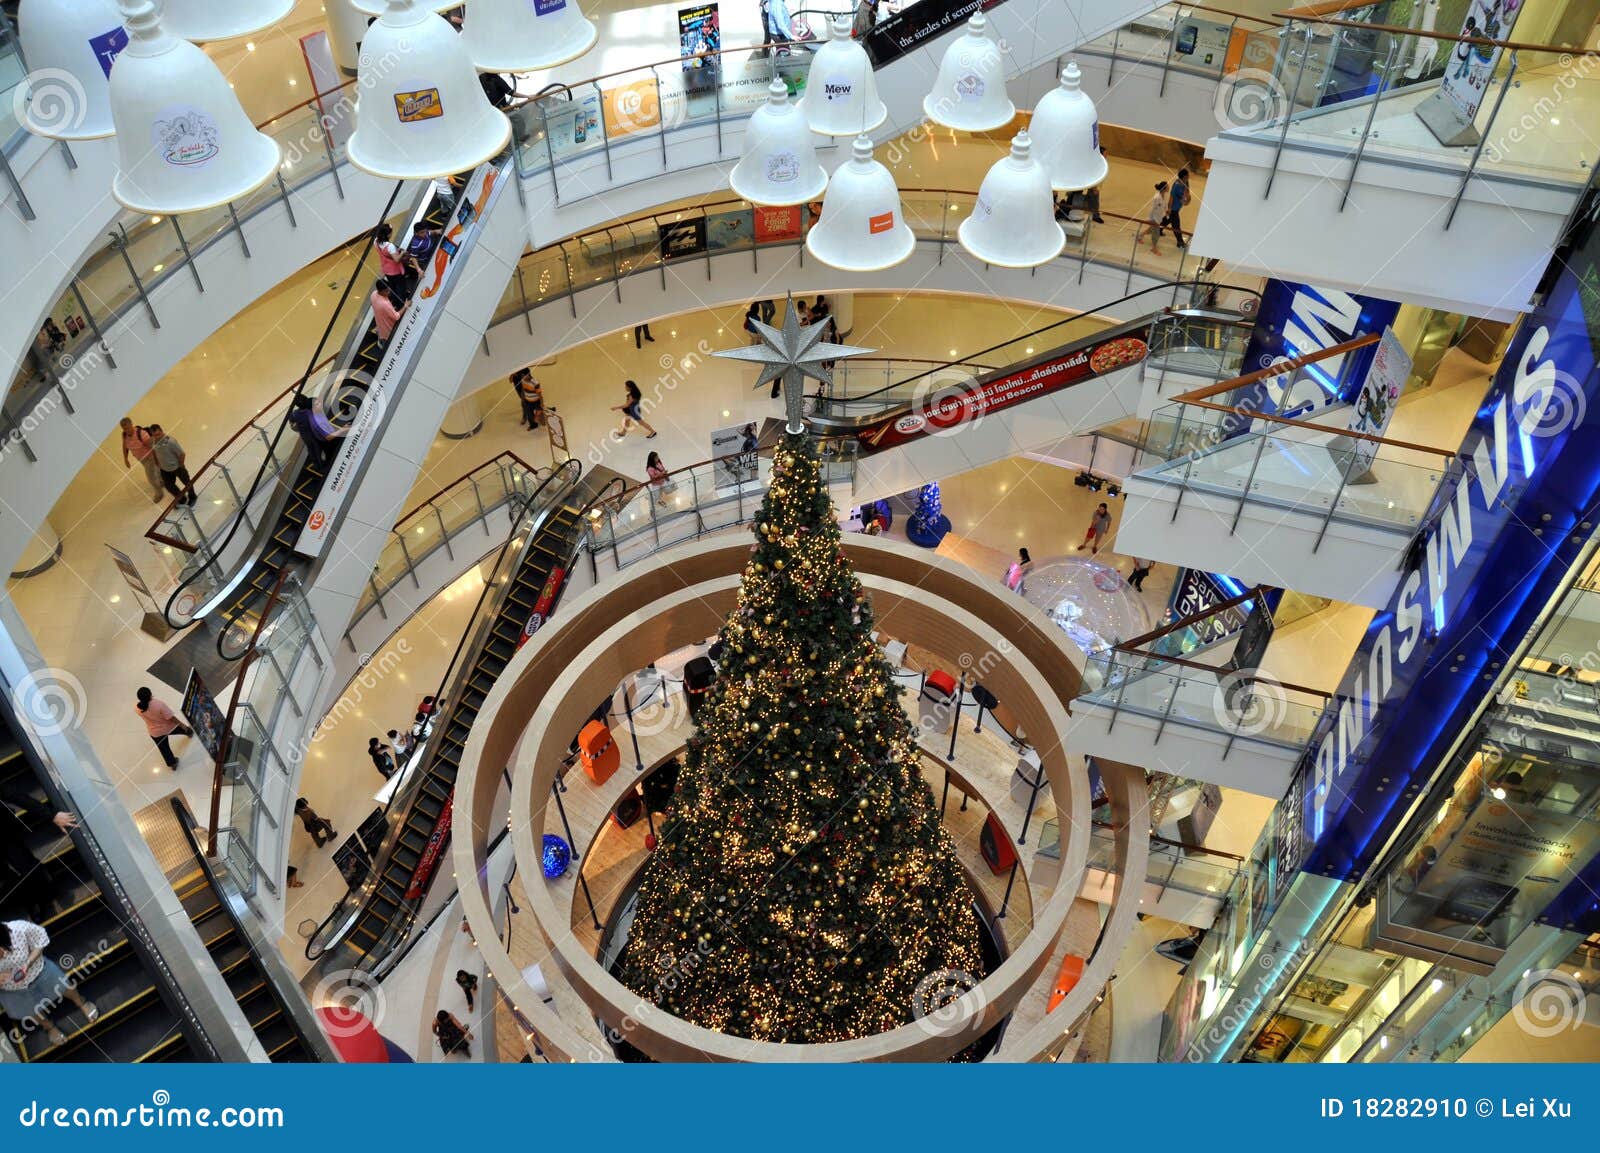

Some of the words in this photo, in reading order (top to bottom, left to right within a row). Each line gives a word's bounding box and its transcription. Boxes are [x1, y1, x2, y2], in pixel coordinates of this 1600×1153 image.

[900, 37, 914, 48] the
[914, 22, 940, 41] sizzles
[941, 12, 952, 25] of
[952, 0, 988, 20] scrump
[750, 77, 770, 85] YOUR
[825, 84, 852, 94] Mew
[1007, 382, 1044, 400] Beacon
[330, 462, 347, 492] SMART
[382, 357, 396, 382] YOUR
[394, 326, 411, 357] SMART
[740, 452, 758, 463] WE
[742, 461, 758, 470] LOVE
